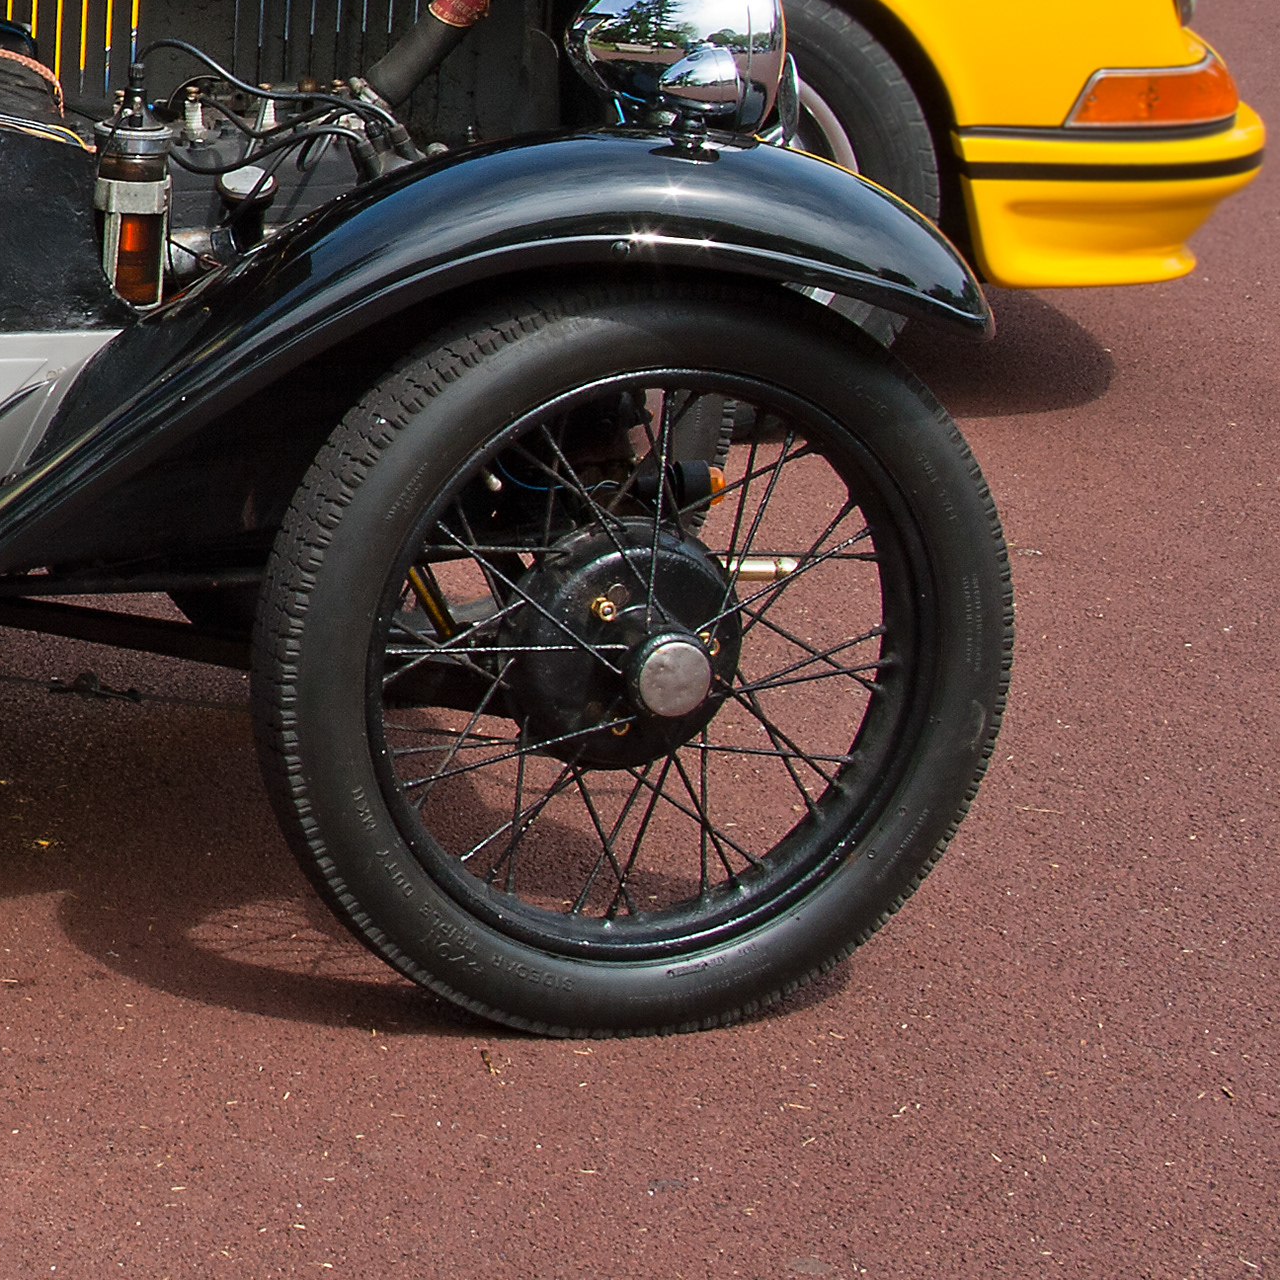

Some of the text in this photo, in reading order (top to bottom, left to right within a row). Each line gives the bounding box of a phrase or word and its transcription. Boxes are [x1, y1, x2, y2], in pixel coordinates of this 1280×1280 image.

[374, 845, 416, 898] DUTY
[418, 901, 480, 955] TRIPLE
[491, 954, 576, 993] SIDECAR
